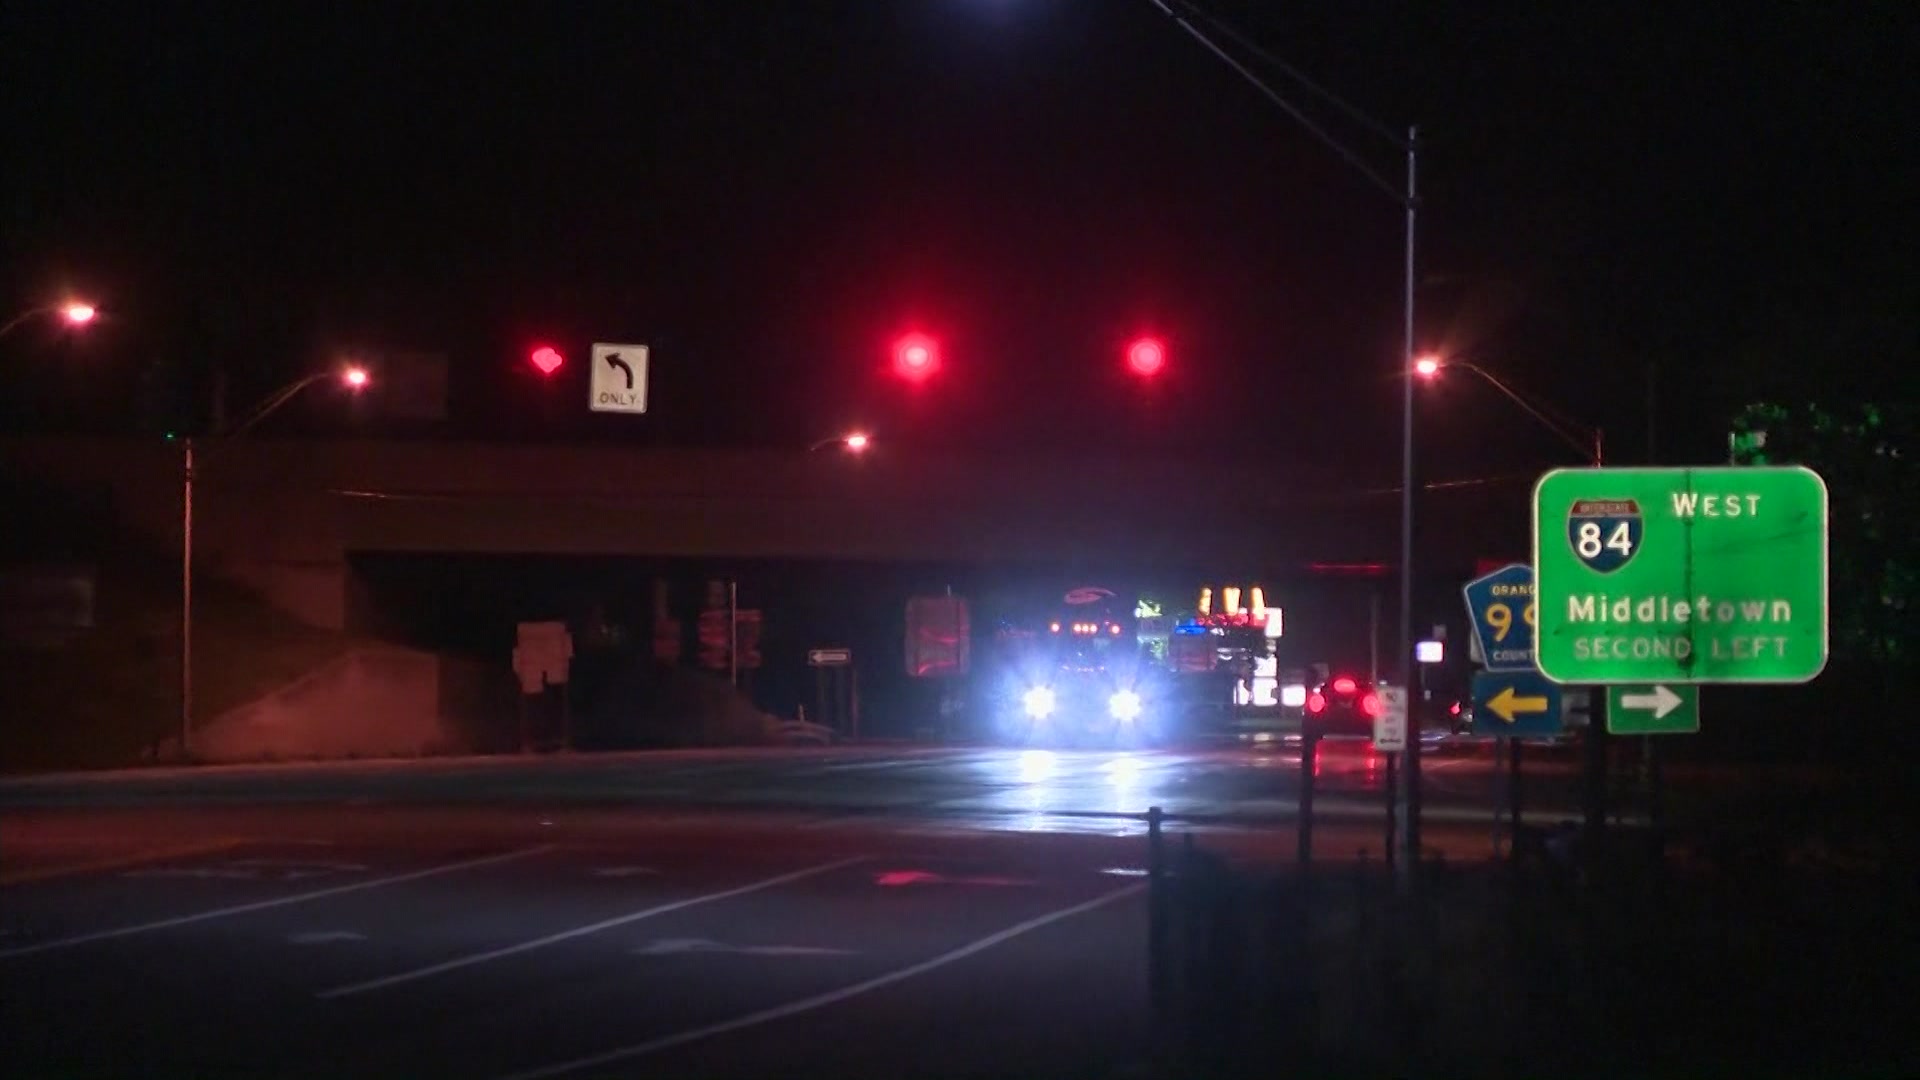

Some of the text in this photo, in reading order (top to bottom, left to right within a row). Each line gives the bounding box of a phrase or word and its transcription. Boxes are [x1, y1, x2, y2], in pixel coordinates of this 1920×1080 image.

[600, 392, 637, 405] ONLY
[1672, 492, 1761, 518] WEST
[1578, 522, 1632, 557] 84
[1492, 585, 1536, 596] ORANG
[1568, 596, 1792, 622] Middletown
[1493, 651, 1535, 661] COUNT
[1574, 636, 1789, 660] SECOND LEFT
